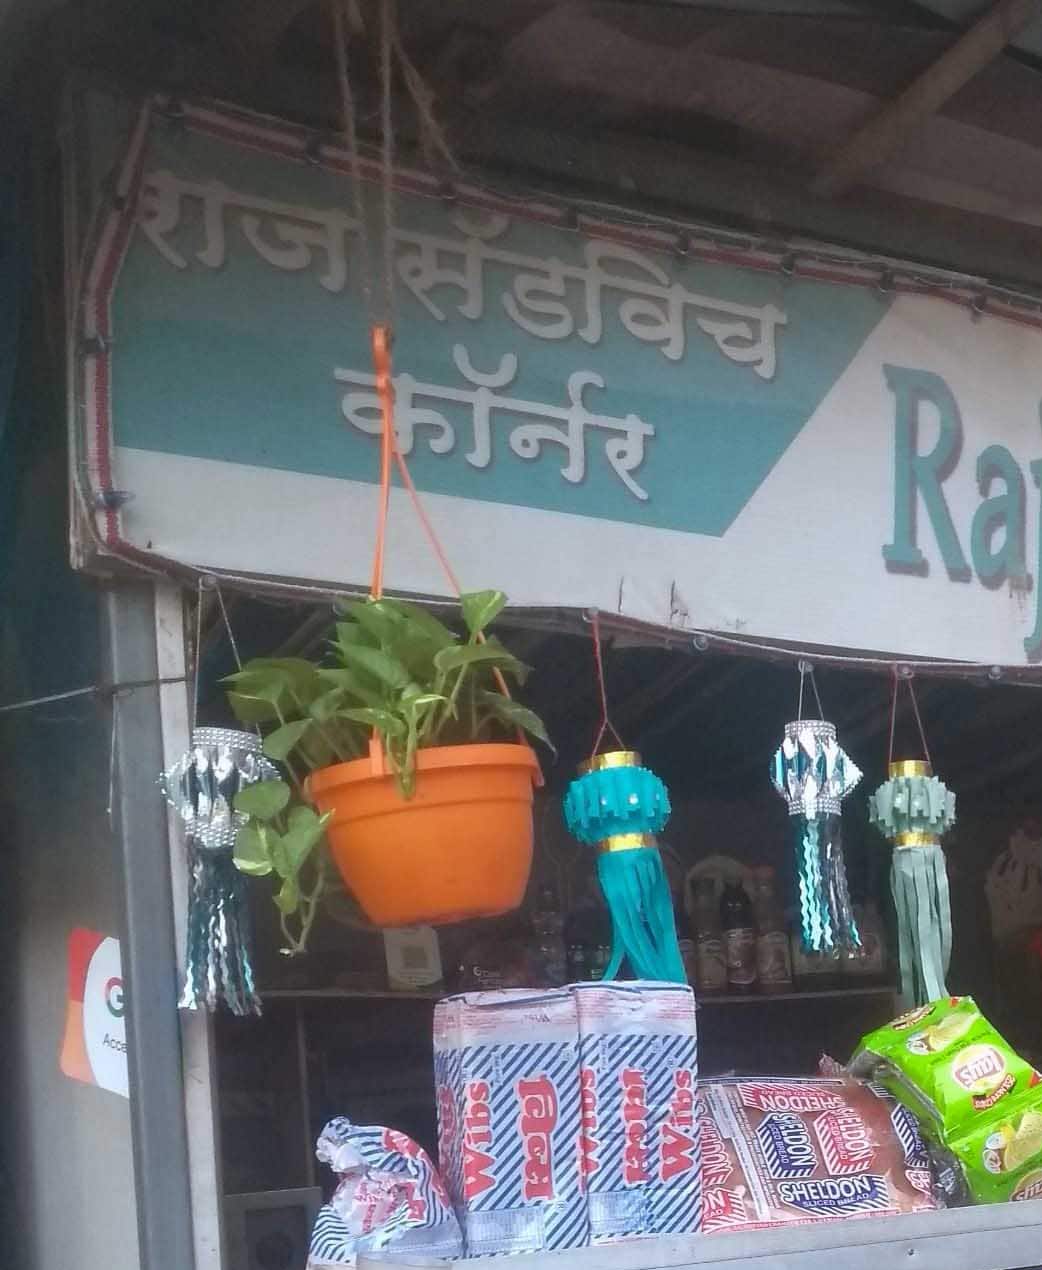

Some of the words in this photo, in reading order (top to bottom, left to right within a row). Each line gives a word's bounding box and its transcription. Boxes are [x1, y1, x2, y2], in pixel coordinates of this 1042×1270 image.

[137, 170, 361, 293] राज
[334, 343, 656, 500] कॉर्नर
[463, 1081, 498, 1201] Wibs
[660, 1069, 697, 1183] Wibs
[759, 1094, 844, 1112] SHELDON
[781, 1175, 873, 1203] SHELDON
